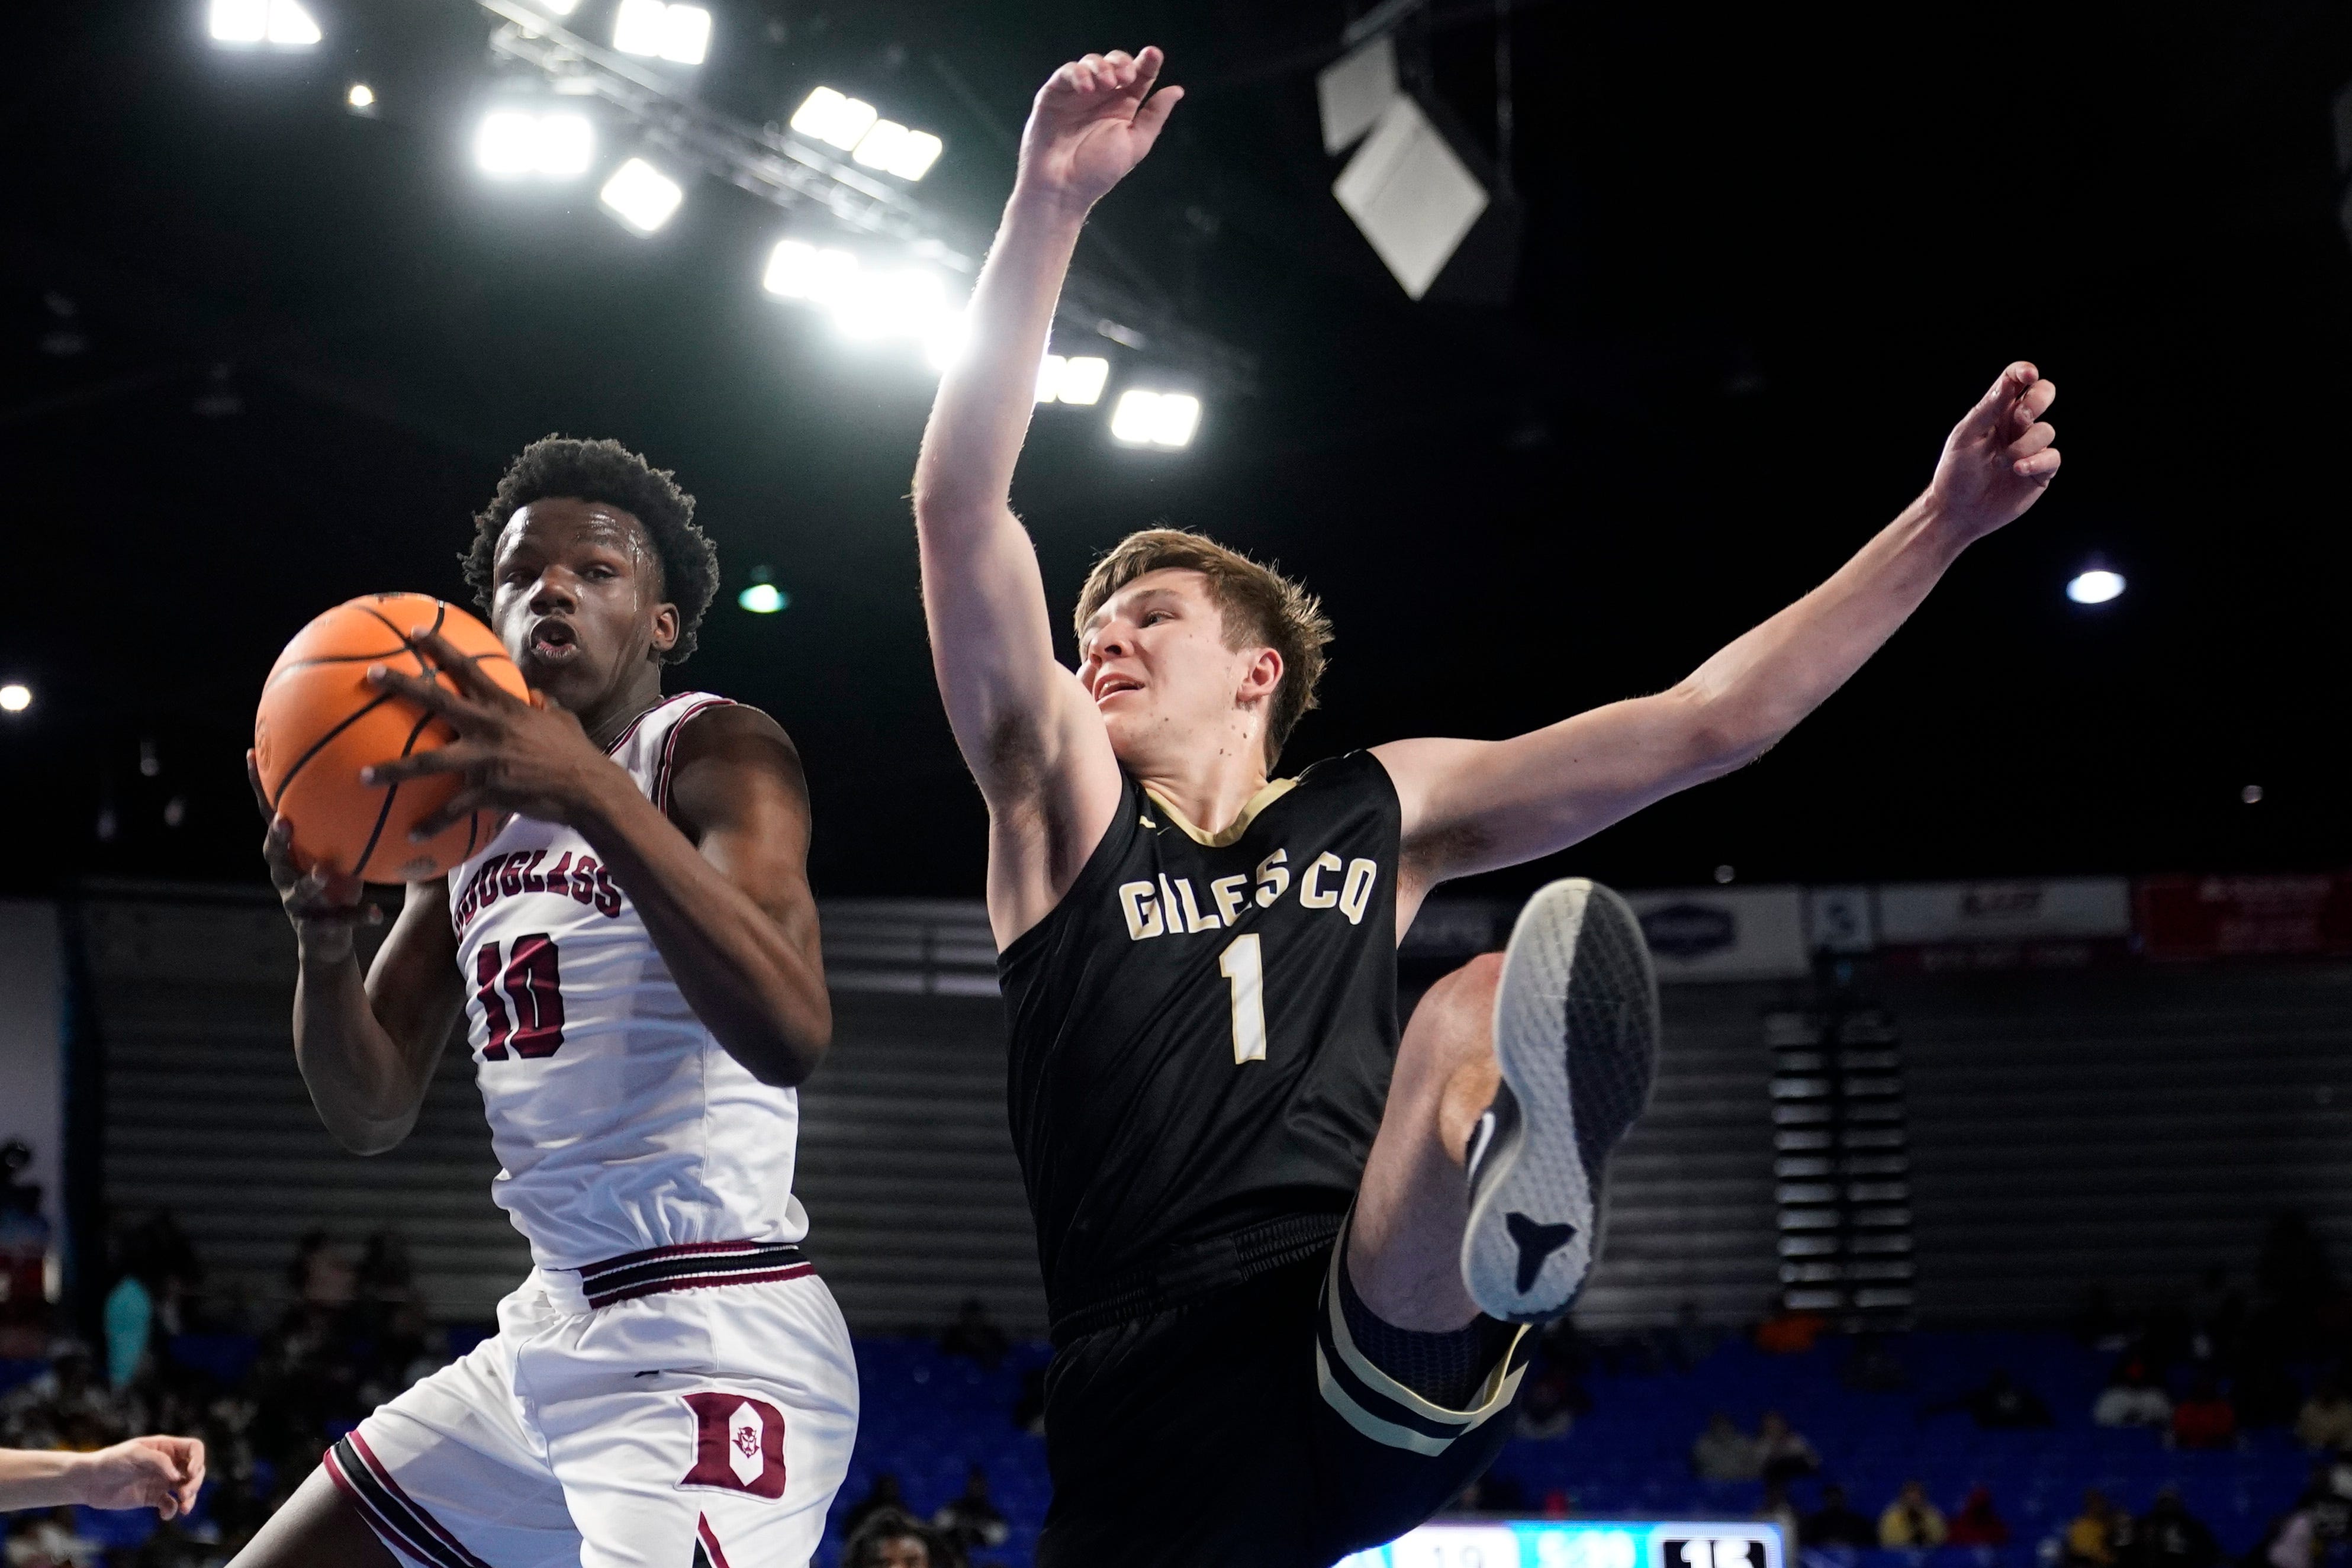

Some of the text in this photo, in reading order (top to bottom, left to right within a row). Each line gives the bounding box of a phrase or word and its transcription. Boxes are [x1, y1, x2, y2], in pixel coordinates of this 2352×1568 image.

[1119, 848, 1290, 941] GILES
[1299, 851, 1377, 925] CO
[477, 933, 565, 1061] 10
[1219, 933, 1266, 1065] 1
[679, 1392, 786, 1500] D
